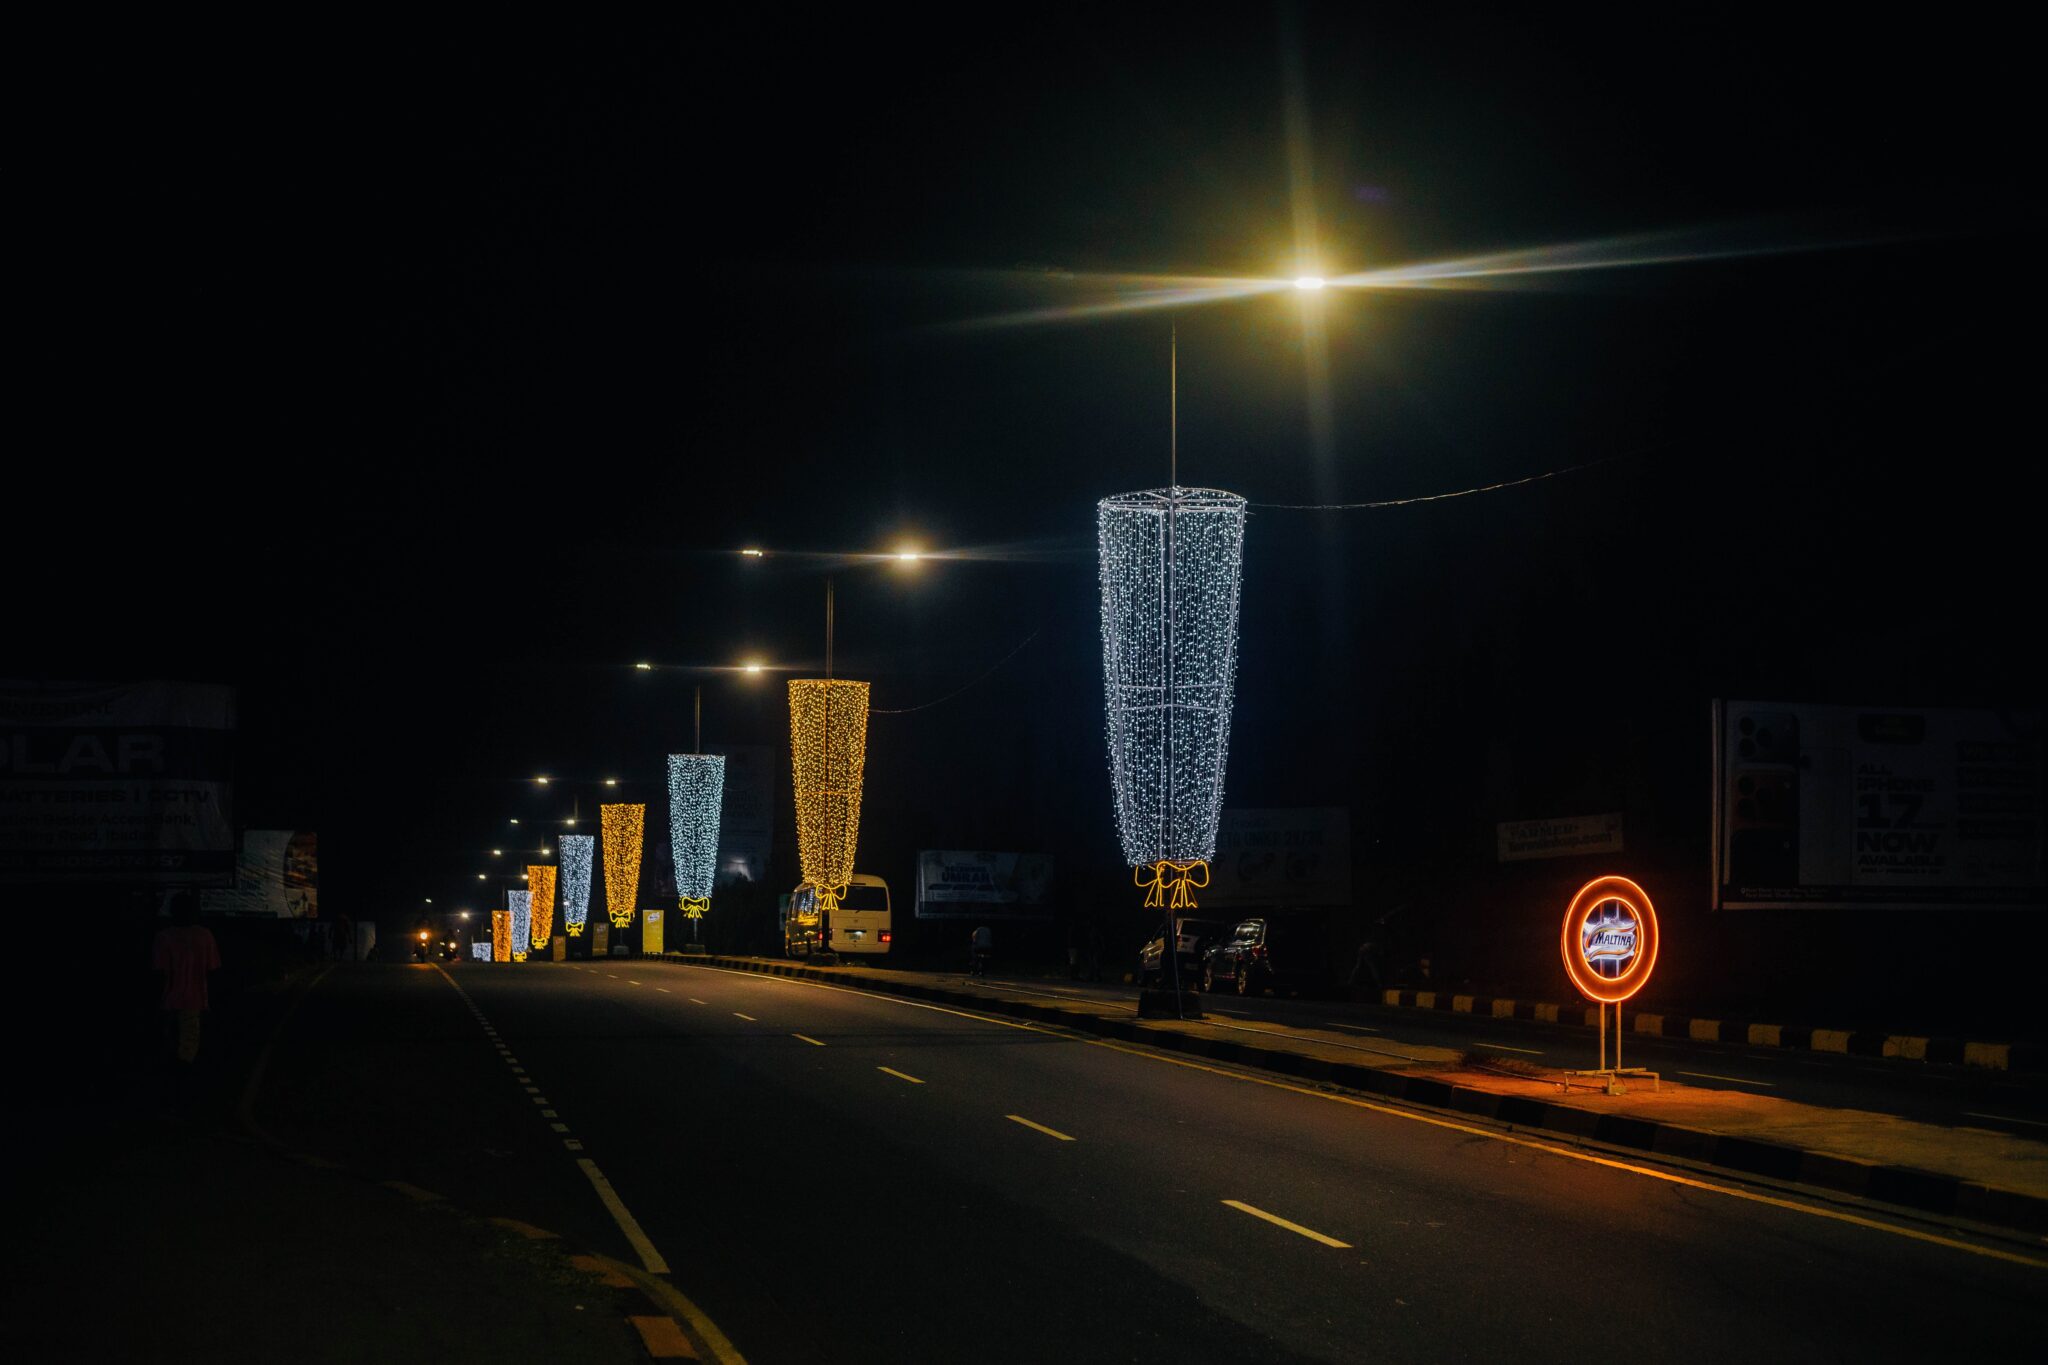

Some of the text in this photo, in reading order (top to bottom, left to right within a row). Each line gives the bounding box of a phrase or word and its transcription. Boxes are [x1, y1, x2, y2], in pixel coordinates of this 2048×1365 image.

[1857, 793, 1923, 829] 17
[1857, 831, 1940, 853] NOW
[1594, 931, 1632, 947] MALTINA
